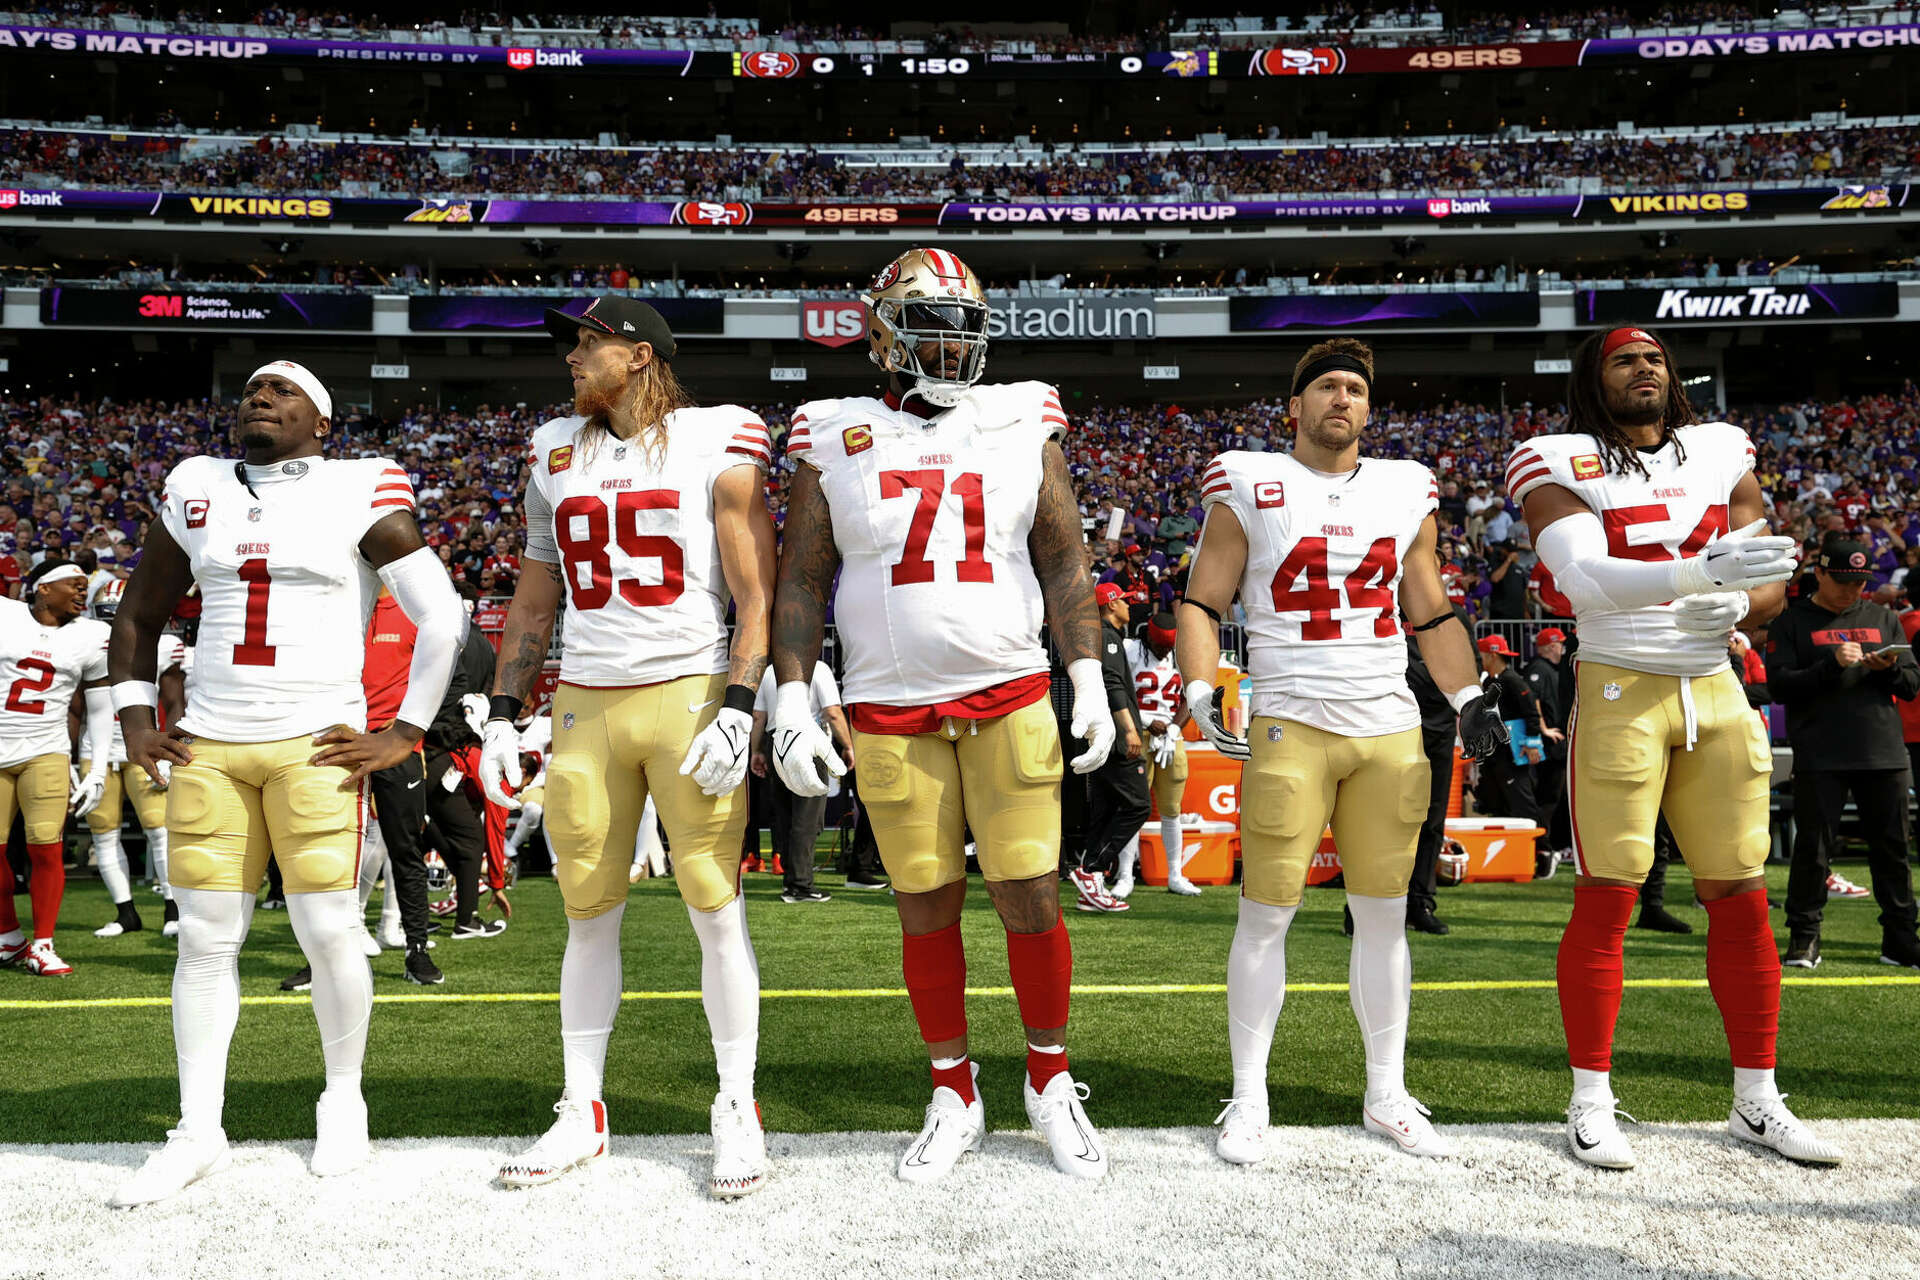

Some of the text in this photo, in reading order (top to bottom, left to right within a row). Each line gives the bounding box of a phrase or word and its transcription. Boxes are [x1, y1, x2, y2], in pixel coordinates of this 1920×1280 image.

[85, 36, 270, 59] MATCHUP
[317, 49, 480, 64] PRESENTED BY
[536, 49, 584, 66] bank
[991, 53, 1014, 63] DOWN
[1066, 53, 1083, 63] BALL
[1408, 48, 1522, 68] 49ERS
[812, 57, 835, 74] 0
[862, 63, 874, 76] 1
[901, 58, 970, 75] 1:50
[1121, 57, 1143, 74] 0
[19, 190, 63, 206] bank
[189, 196, 332, 217] VIKINGS
[1450, 198, 1491, 213] bank
[1609, 192, 1750, 214] VIKINGS
[804, 208, 898, 223] 49ERS
[968, 205, 1237, 222] TODAY'S MATCHUP
[1275, 205, 1405, 217] PRESENTED BY
[138, 294, 182, 318] 3M
[186, 295, 231, 307] Science.
[186, 307, 227, 320] Applied
[229, 308, 241, 319] to
[987, 298, 1154, 337] stadium
[917, 454, 954, 466] 49ERS
[600, 478, 633, 491] 49ERS
[878, 469, 995, 588] 71
[1320, 524, 1355, 538] 49ERS
[235, 543, 270, 556] 49ERS
[554, 489, 685, 611] 85
[1270, 536, 1399, 641] 44
[232, 558, 276, 667] 1
[5, 656, 57, 716] 2
[1135, 670, 1182, 713] 24
